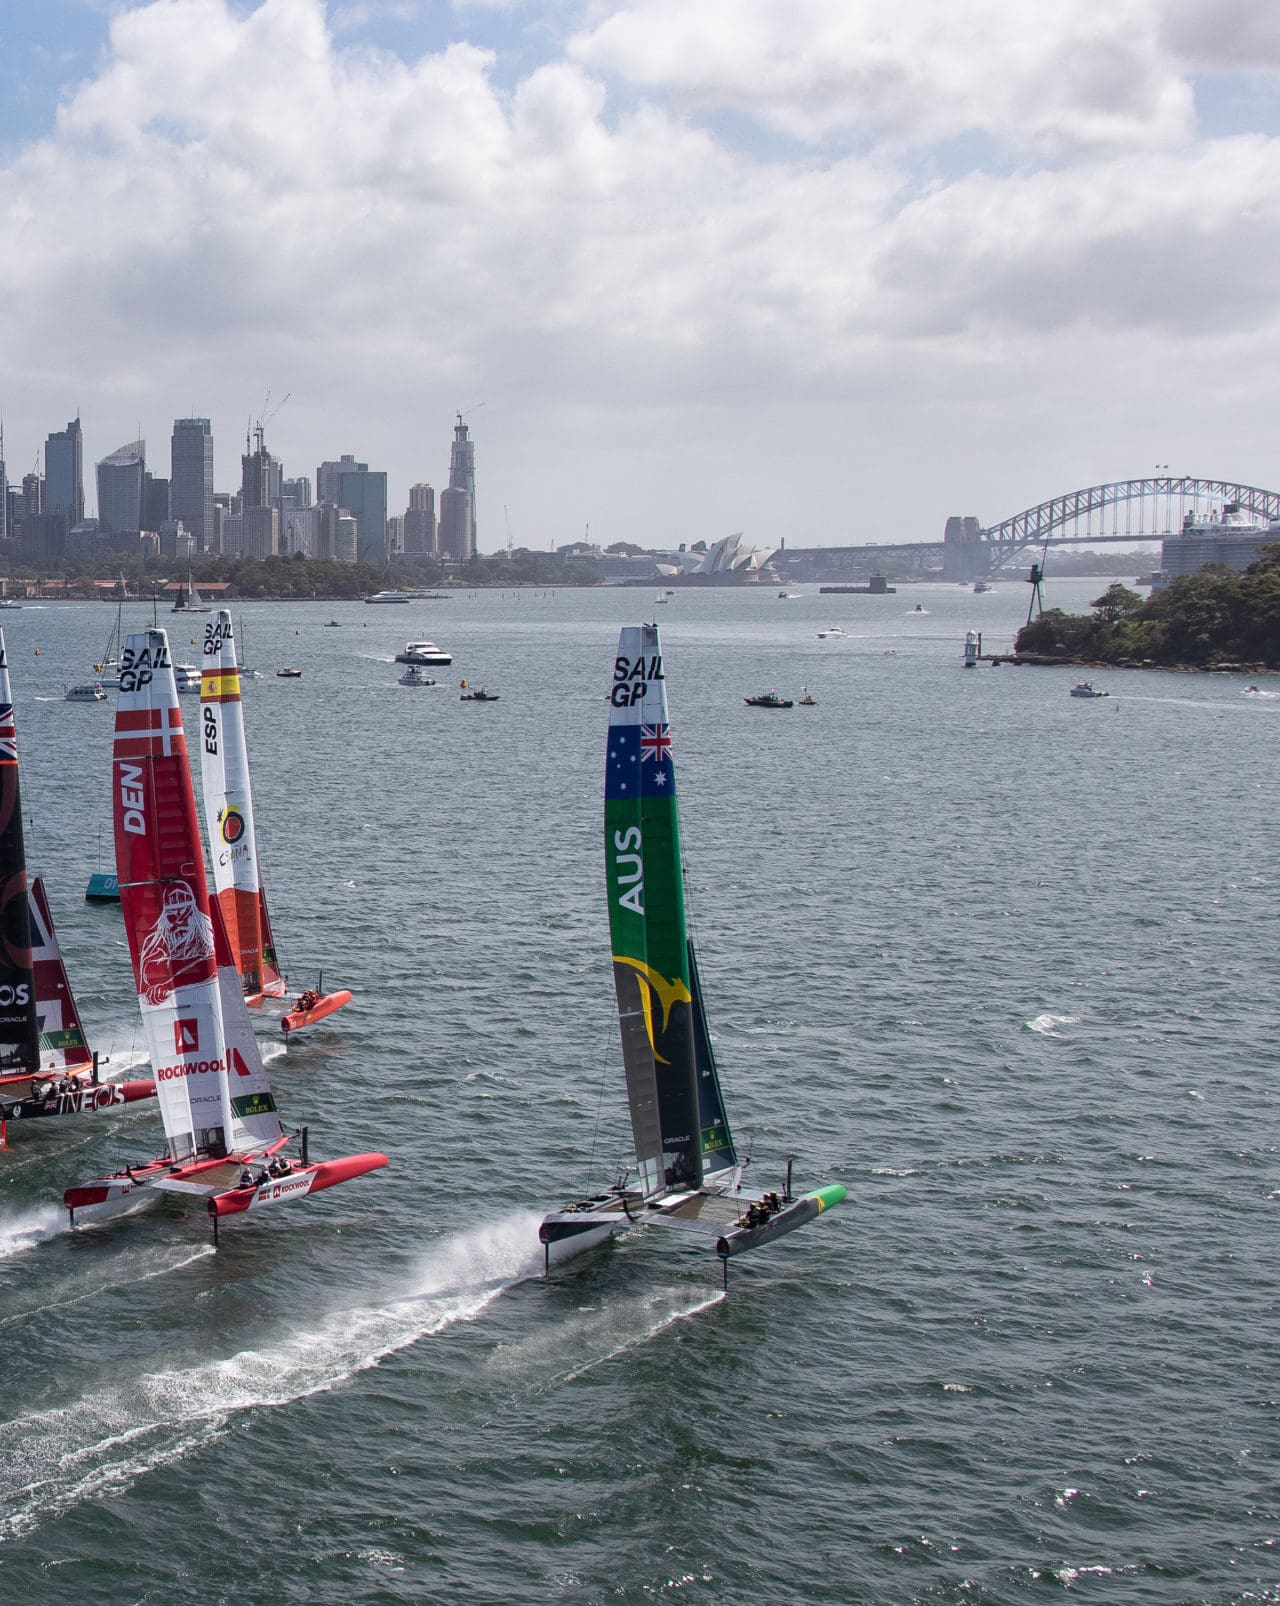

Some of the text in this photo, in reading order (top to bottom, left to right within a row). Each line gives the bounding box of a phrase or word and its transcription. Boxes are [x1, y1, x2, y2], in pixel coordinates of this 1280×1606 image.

[205, 624, 234, 639] SAIL
[204, 640, 223, 655] GP
[121, 648, 171, 670] SAIL
[614, 656, 664, 681] SAIL
[119, 671, 153, 692] GP
[611, 682, 648, 708] GP
[204, 706, 218, 755] ESP
[120, 763, 146, 835] DEN
[614, 826, 645, 916] AUS
[157, 1059, 226, 1081] ROCKWOOL
[56, 1084, 125, 1114] INEOS
[190, 1095, 222, 1104] ORACLE
[246, 1104, 269, 1114] ROLEX
[664, 1135, 691, 1144] ORACLE
[282, 1180, 310, 1193] ROCKWOOL
